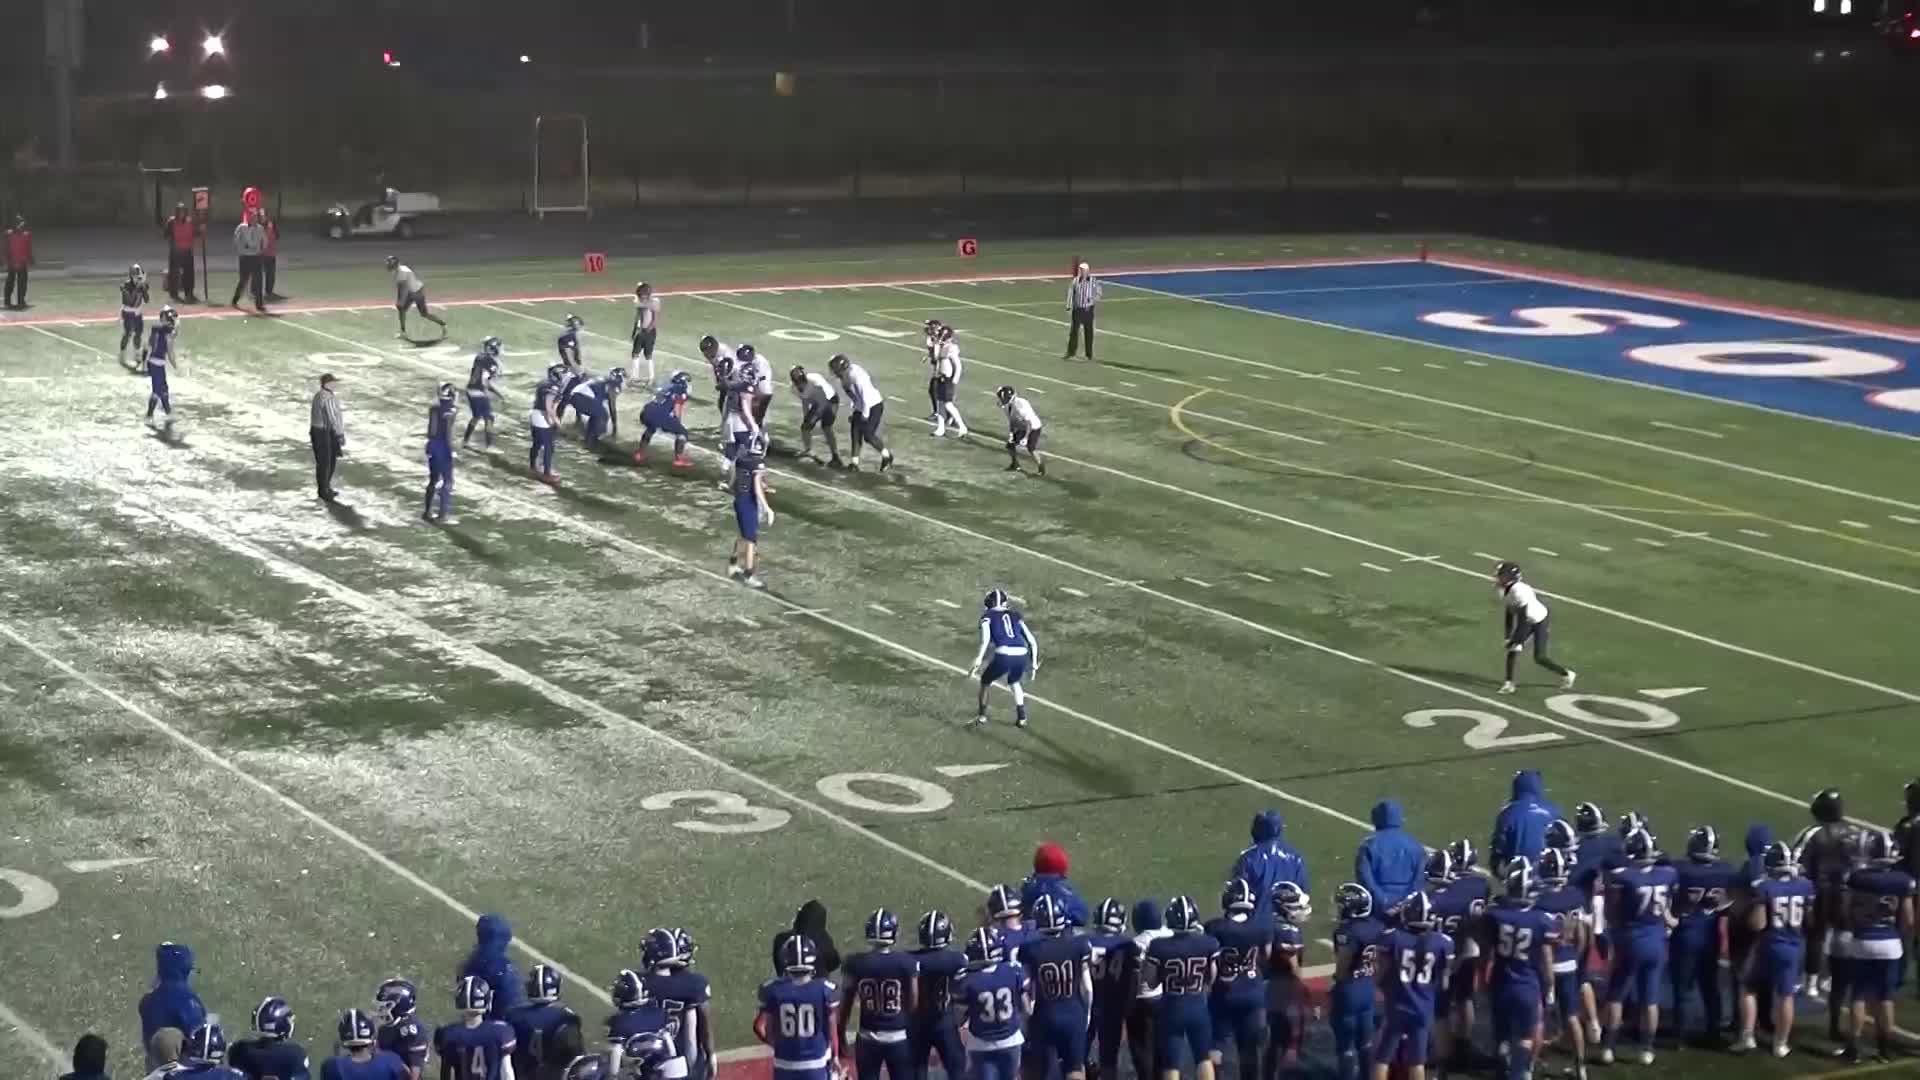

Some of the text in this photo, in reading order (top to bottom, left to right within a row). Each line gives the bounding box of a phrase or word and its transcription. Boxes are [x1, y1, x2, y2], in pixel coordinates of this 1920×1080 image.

[961, 240, 977, 256] G
[1417, 306, 1920, 413] SO
[1401, 693, 1681, 750] 20
[640, 771, 954, 834] 30
[1773, 895, 1805, 928] 56
[1499, 923, 1533, 961] 52
[1164, 956, 1208, 995] 25
[1400, 949, 1437, 984] 53
[779, 1002, 816, 1039] 60
[978, 986, 1014, 1024] 33
